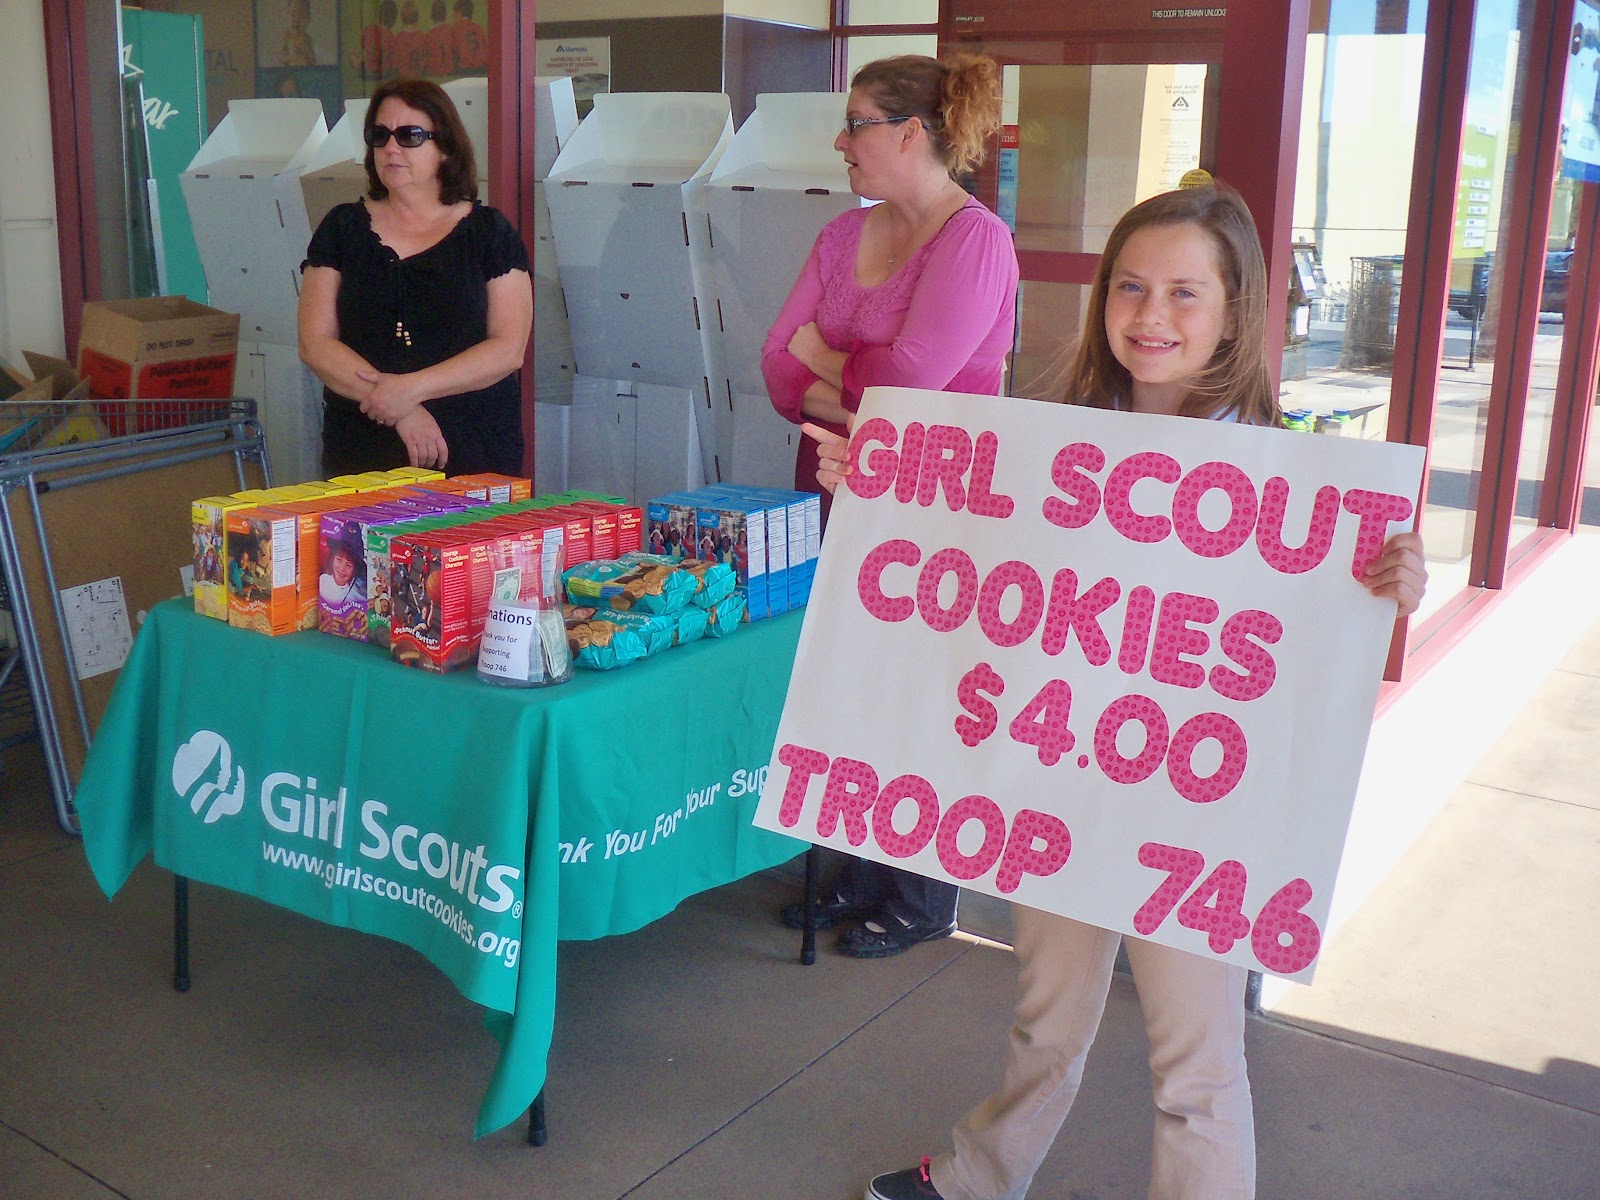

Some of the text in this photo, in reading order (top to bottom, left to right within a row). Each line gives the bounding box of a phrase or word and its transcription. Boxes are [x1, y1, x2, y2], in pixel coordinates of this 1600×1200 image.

[1152, 10, 1163, 18] THIS
[1163, 10, 1177, 18] DOOR
[1177, 10, 1184, 18] TO
[1185, 9, 1204, 17] REMAIN
[146, 343, 157, 351] DO
[159, 341, 173, 349] NOT
[845, 418, 1413, 583] GIRL SCOUT
[444, 561, 464, 569] Character
[448, 554, 469, 562] Confidence
[393, 626, 438, 645] Peanut Butter
[507, 635, 518, 643] for
[857, 539, 1283, 702] COOKIES
[495, 663, 507, 672] 746
[954, 662, 1248, 804] $4.00
[260, 772, 347, 849] Girl
[603, 829, 647, 860] You
[651, 808, 681, 846] For
[685, 782, 721, 820] Your
[777, 743, 1322, 974] TROOP 746
[262, 840, 520, 968] www.girlscoutcookies.org
